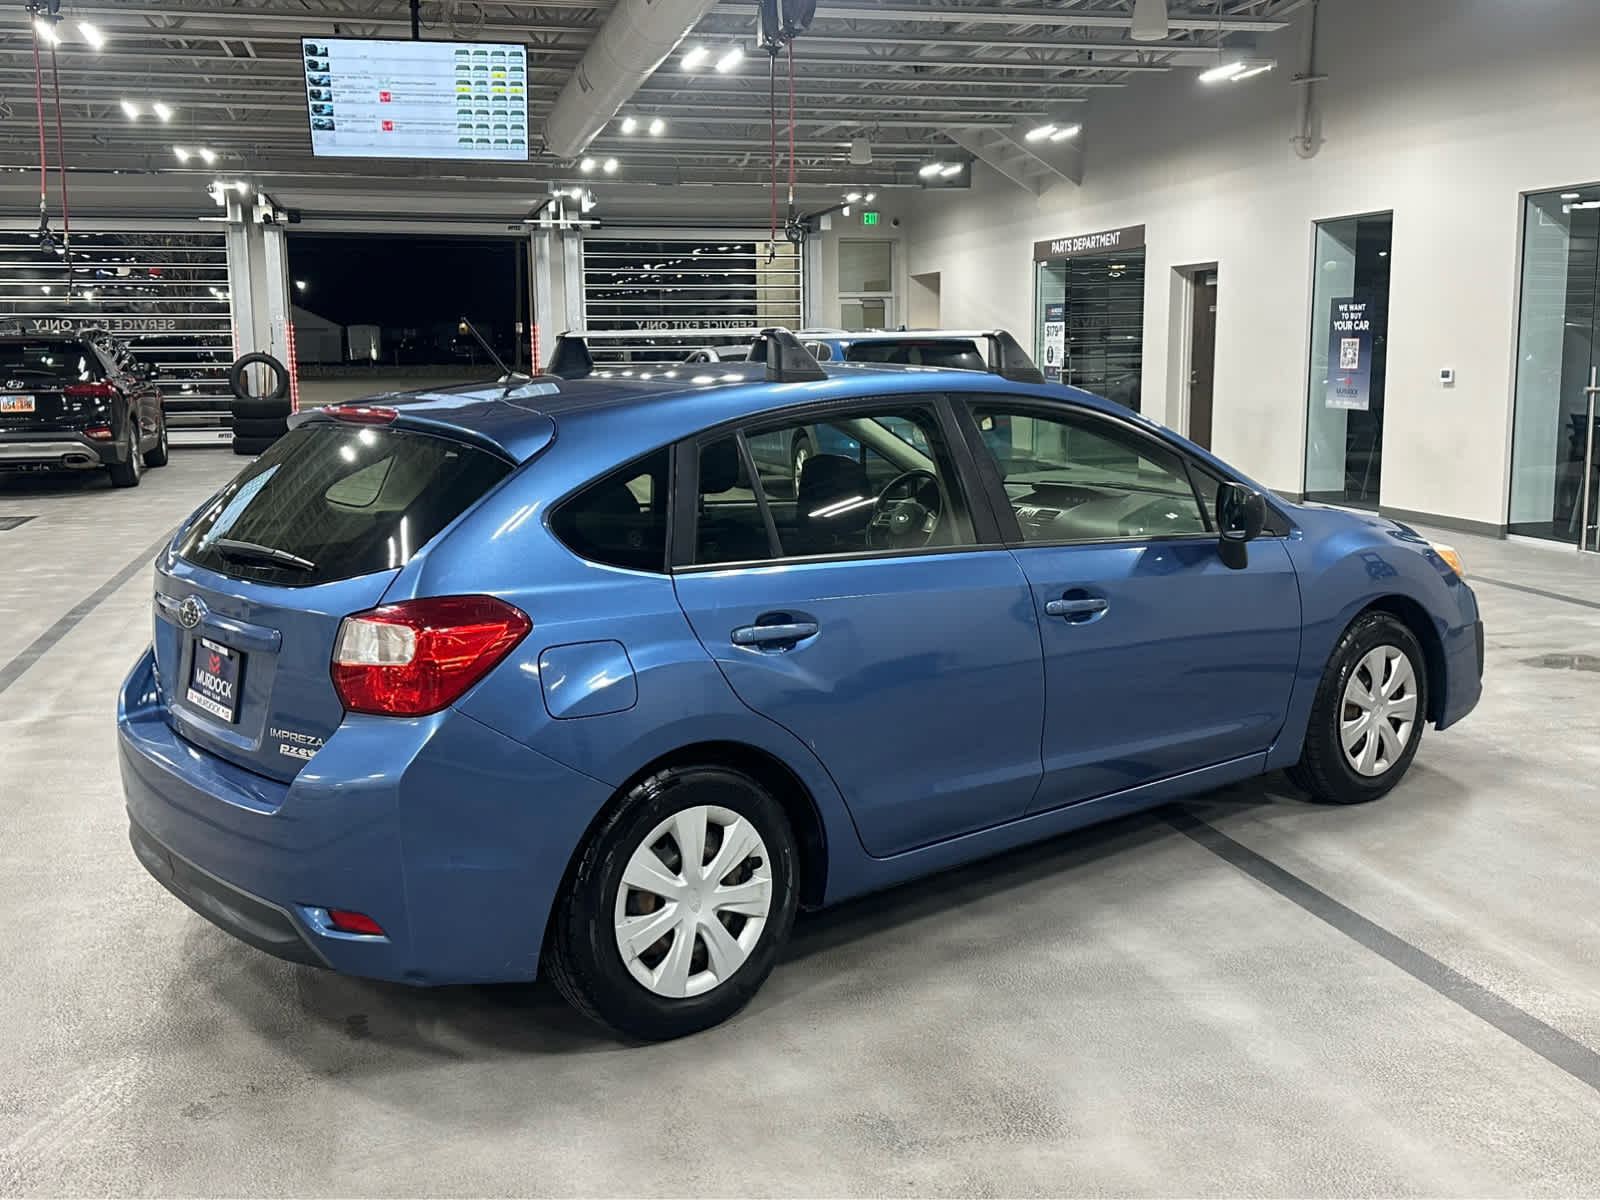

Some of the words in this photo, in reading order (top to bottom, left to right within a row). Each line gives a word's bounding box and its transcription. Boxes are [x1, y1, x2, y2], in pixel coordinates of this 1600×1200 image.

[1051, 239, 1072, 254] PARTS
[1073, 231, 1120, 251] DEPARTMENT
[1349, 303, 1366, 311] WANT
[1341, 312, 1349, 320] TO
[1350, 312, 1362, 320] BUY
[1333, 320, 1353, 330] YOUR
[1353, 320, 1370, 330] CAR
[195, 667, 232, 698] MURDOCK
[270, 727, 325, 747] IMPREZA
